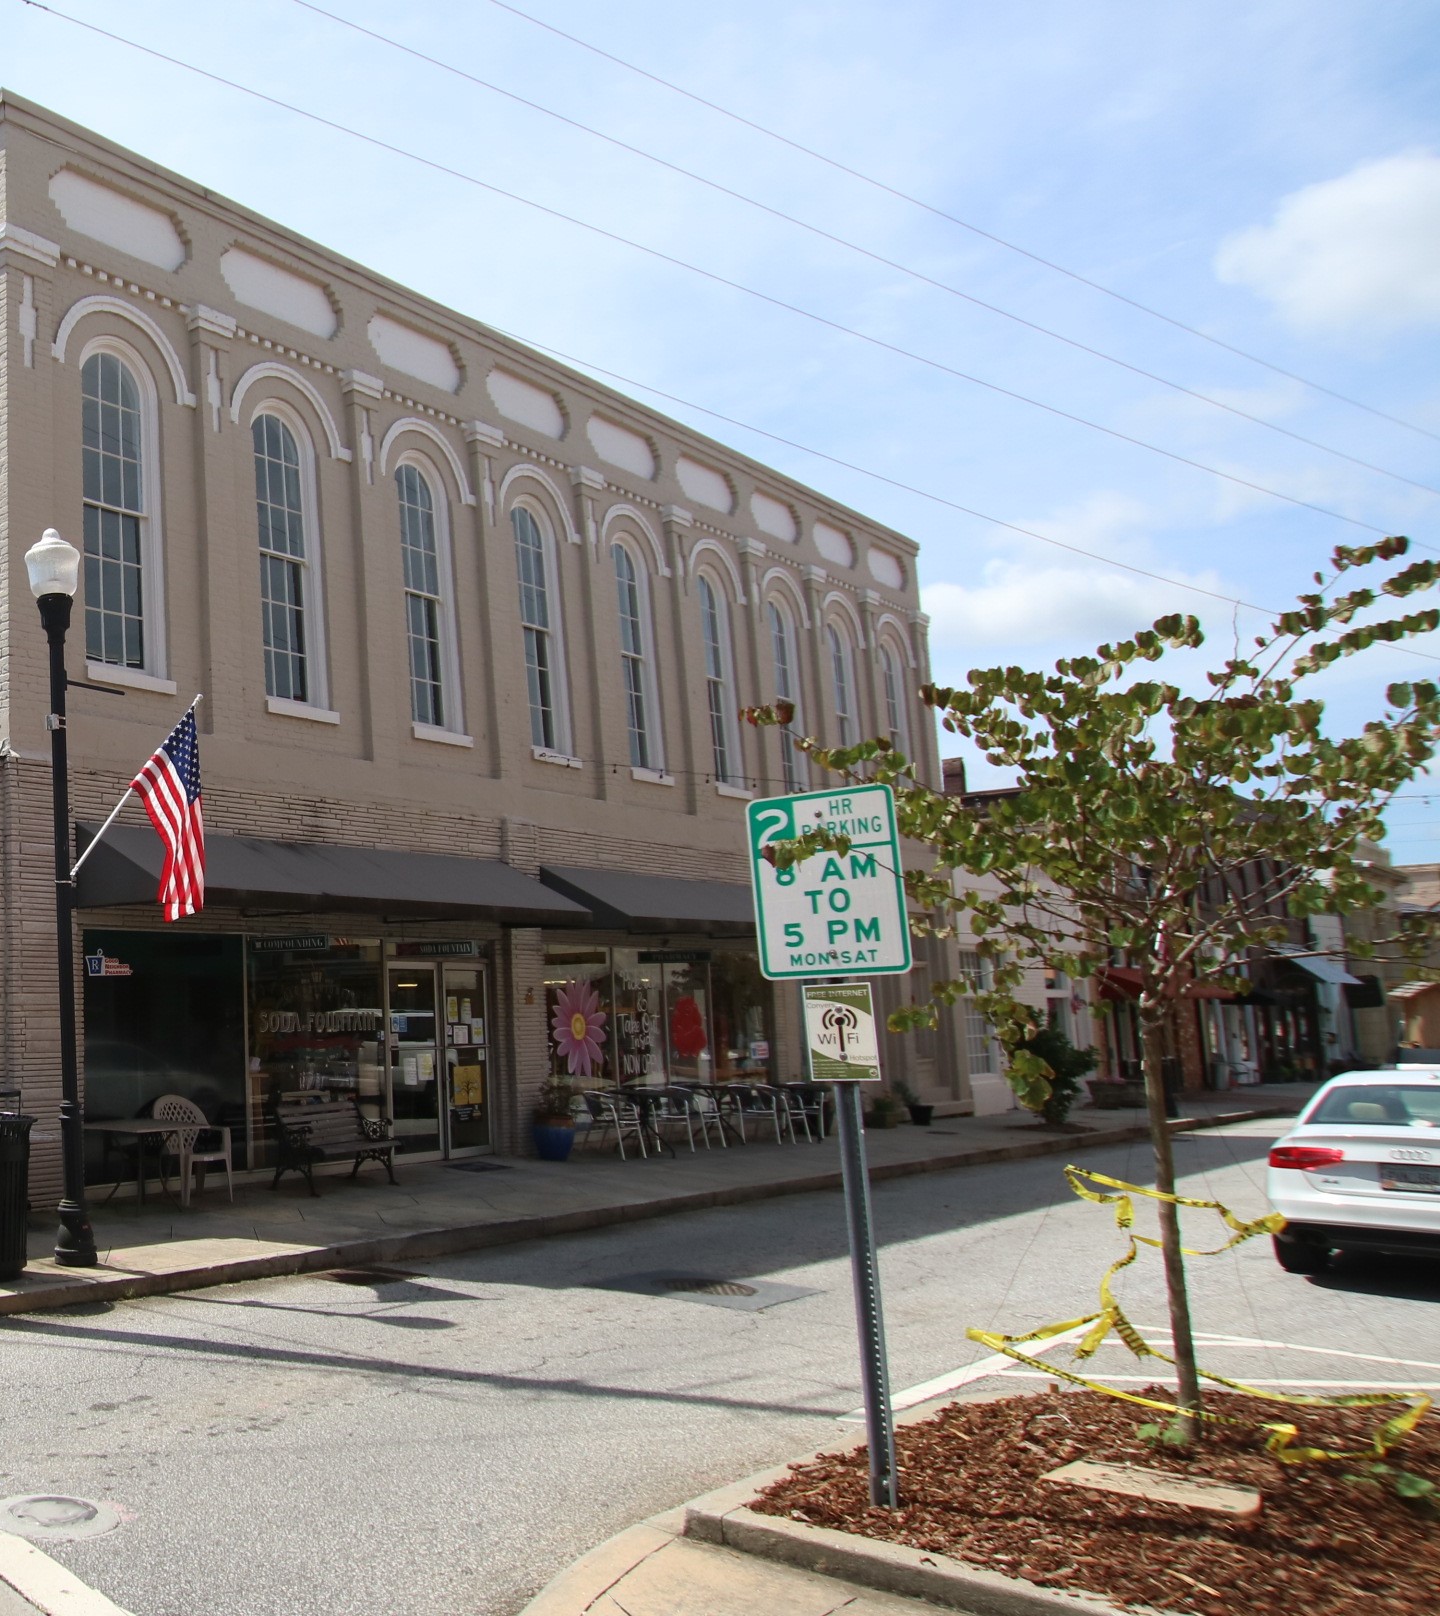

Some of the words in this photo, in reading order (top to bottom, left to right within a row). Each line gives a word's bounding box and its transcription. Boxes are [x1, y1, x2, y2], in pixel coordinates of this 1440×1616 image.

[755, 808, 789, 849] 2
[828, 798, 853, 816] HR
[802, 815, 883, 836] PRKING
[821, 853, 877, 883] AM
[804, 887, 851, 914] TO
[263, 938, 323, 949] COMPOUNDING
[783, 922, 805, 948] 5
[827, 916, 882, 945] PM
[419, 944, 437, 953] SODA
[438, 943, 471, 953] FOUNTAIN
[828, 989, 868, 998] INTERNET
[259, 1011, 302, 1033] SODA
[306, 1011, 376, 1033] FOUNTAIN
[616, 1013, 640, 1038] Take
[641, 1012, 661, 1035] Out
[623, 1054, 641, 1080] NOW
[849, 1054, 878, 1062] Hotspot
